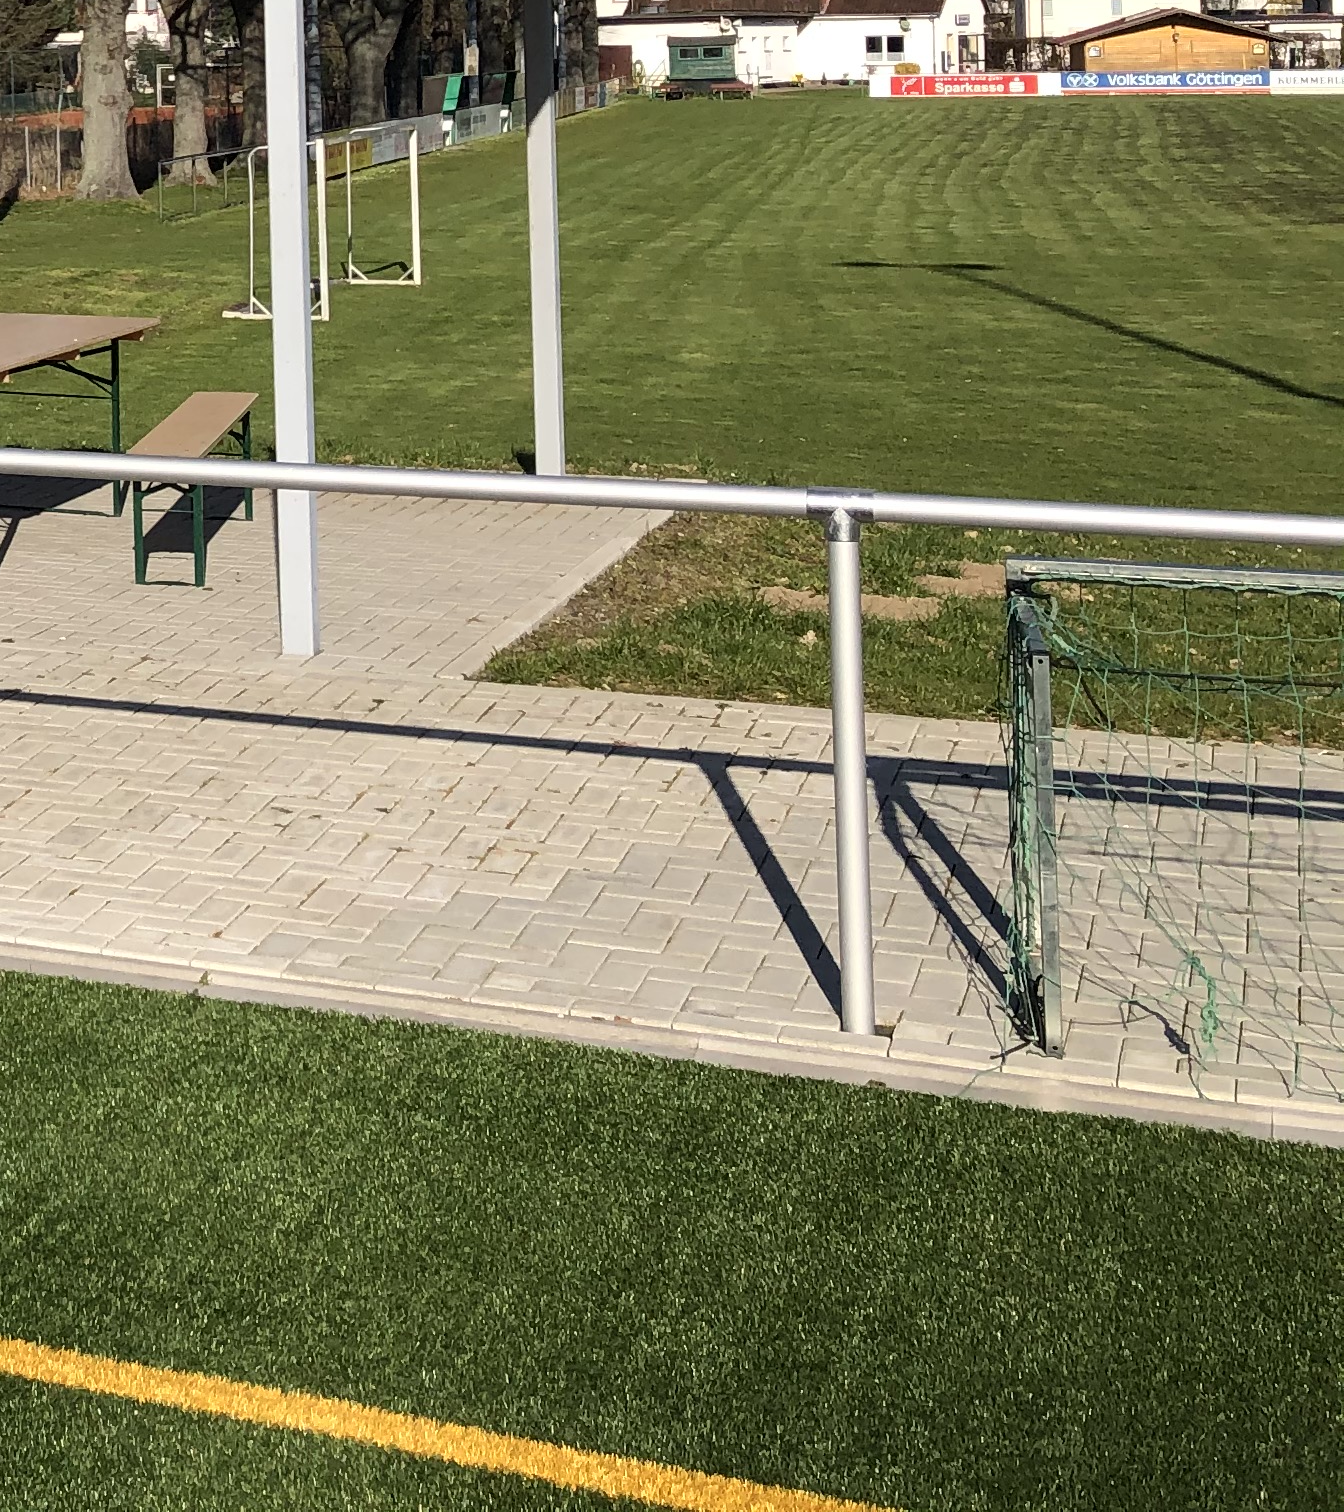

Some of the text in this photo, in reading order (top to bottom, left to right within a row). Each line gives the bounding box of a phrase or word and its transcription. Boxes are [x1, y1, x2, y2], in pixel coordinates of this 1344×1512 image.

[1107, 72, 1263, 87] Volksbank Göttingen
[934, 82, 1005, 96] Sparkasse
